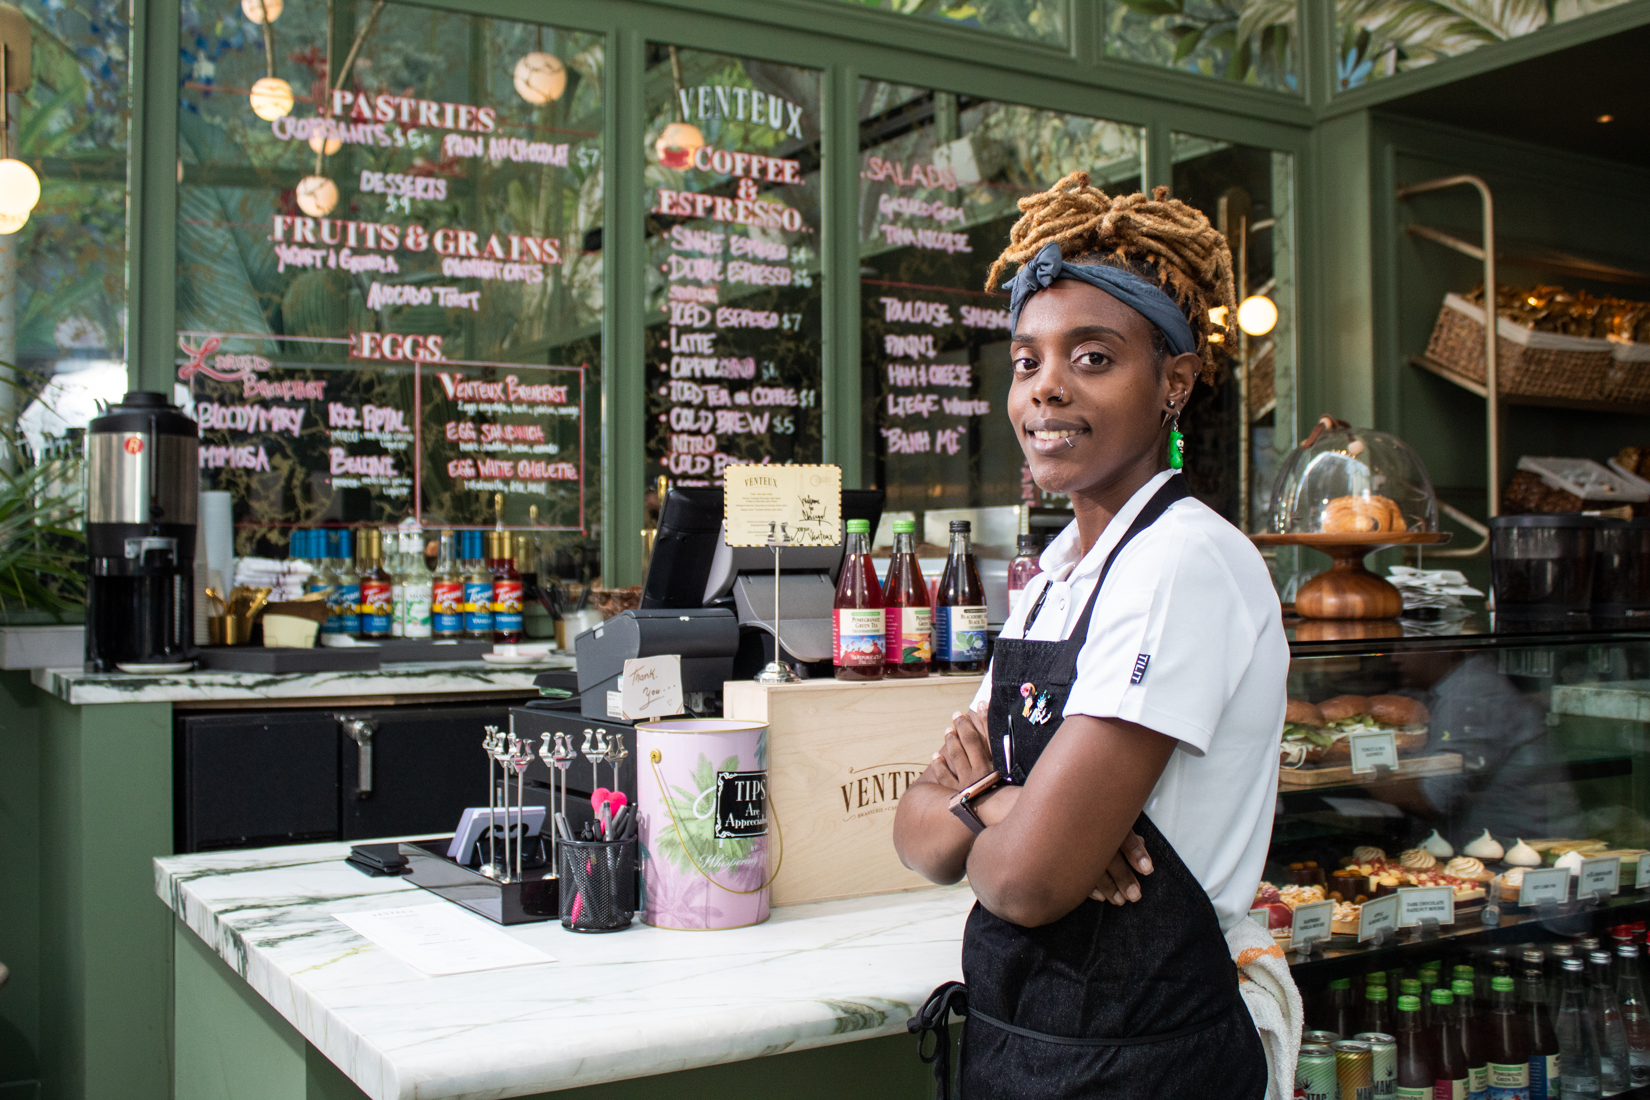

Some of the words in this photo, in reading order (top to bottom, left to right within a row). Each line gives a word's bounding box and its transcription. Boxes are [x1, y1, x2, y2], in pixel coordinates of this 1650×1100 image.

[679, 85, 803, 140] VENTEUX
[272, 116, 391, 147] CROISSANTS
[444, 133, 484, 158] PAIN
[359, 170, 447, 201] DESSERTS
[867, 156, 957, 191] SALADS
[736, 177, 758, 200] &
[271, 214, 400, 249] FRUITS
[403, 223, 429, 252] &
[367, 281, 432, 311] AVOCADO
[432, 286, 480, 312] TOAST
[669, 301, 711, 328] ICED
[781, 313, 803, 332] $7
[880, 297, 953, 327] TOULOUSE
[670, 326, 717, 355] LATTE
[435, 372, 505, 401] VENTEUX
[887, 363, 918, 387] HAM
[669, 380, 704, 405] ICED
[701, 384, 732, 407] TEA
[751, 386, 798, 407] COFFEE
[198, 402, 260, 434] BLOODY
[260, 405, 305, 437] MARY
[328, 402, 362, 428] KIR
[362, 404, 410, 433] ROYAL
[670, 406, 713, 434] COLD
[715, 410, 770, 435] BREW
[772, 415, 796, 435] $5
[445, 421, 476, 441] EGG
[480, 423, 544, 443] SANDWICH
[671, 433, 716, 454] NITRO
[199, 446, 270, 472] MIMOSA
[447, 458, 476, 478] EGG
[477, 458, 514, 478] WHITE
[517, 459, 578, 480] OMELETTE
[669, 453, 711, 475] COLD
[744, 476, 778, 488] VENTEUX
[1132, 655, 1149, 683] TILIT
[734, 779, 766, 801] TIPS
[841, 770, 922, 813] VENTE
[745, 802, 760, 816] Are
[857, 805, 884, 818] BRASSERIE
[699, 853, 759, 874] Whispering
